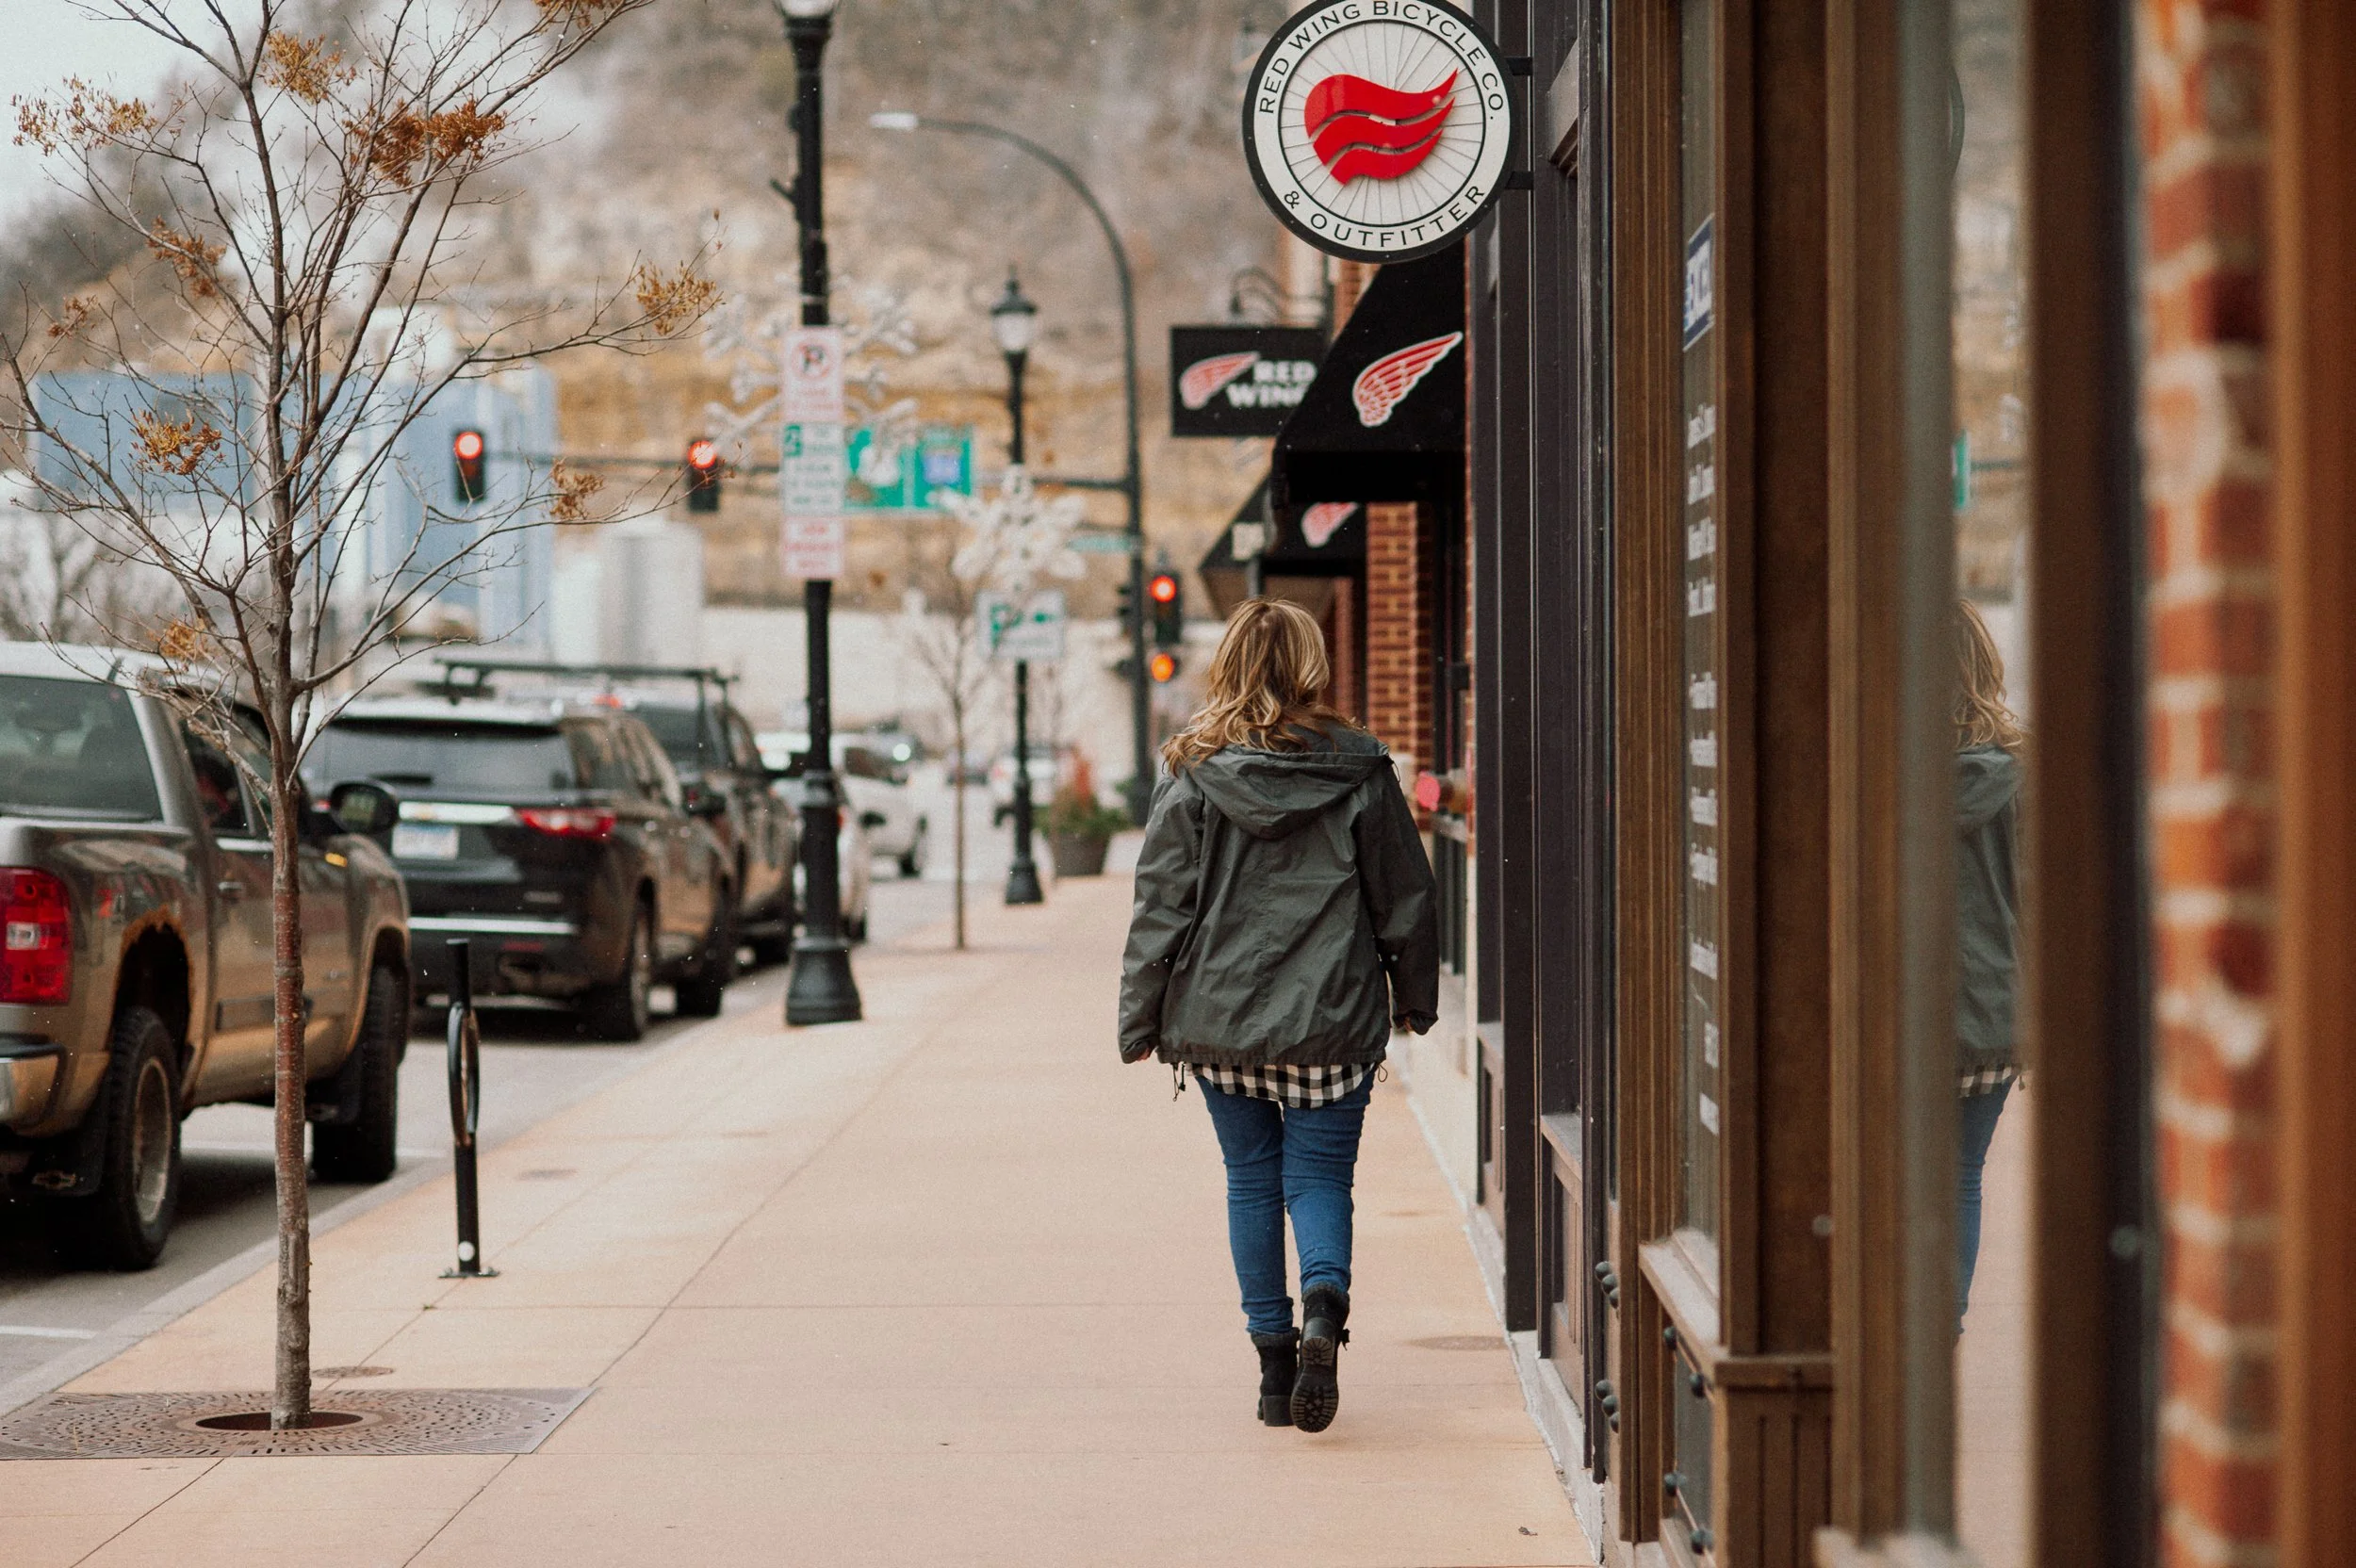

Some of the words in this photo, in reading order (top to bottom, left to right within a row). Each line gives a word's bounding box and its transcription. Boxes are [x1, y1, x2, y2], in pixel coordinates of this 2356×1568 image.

[1259, 57, 1289, 114] RED
[1288, 3, 1362, 51] WING
[1372, 1, 1486, 66] BICYCLE
[1481, 73, 1504, 120] CO.
[1284, 190, 1301, 209] &
[1310, 186, 1485, 248] OUTFITTER
[1252, 361, 1317, 383] RED
